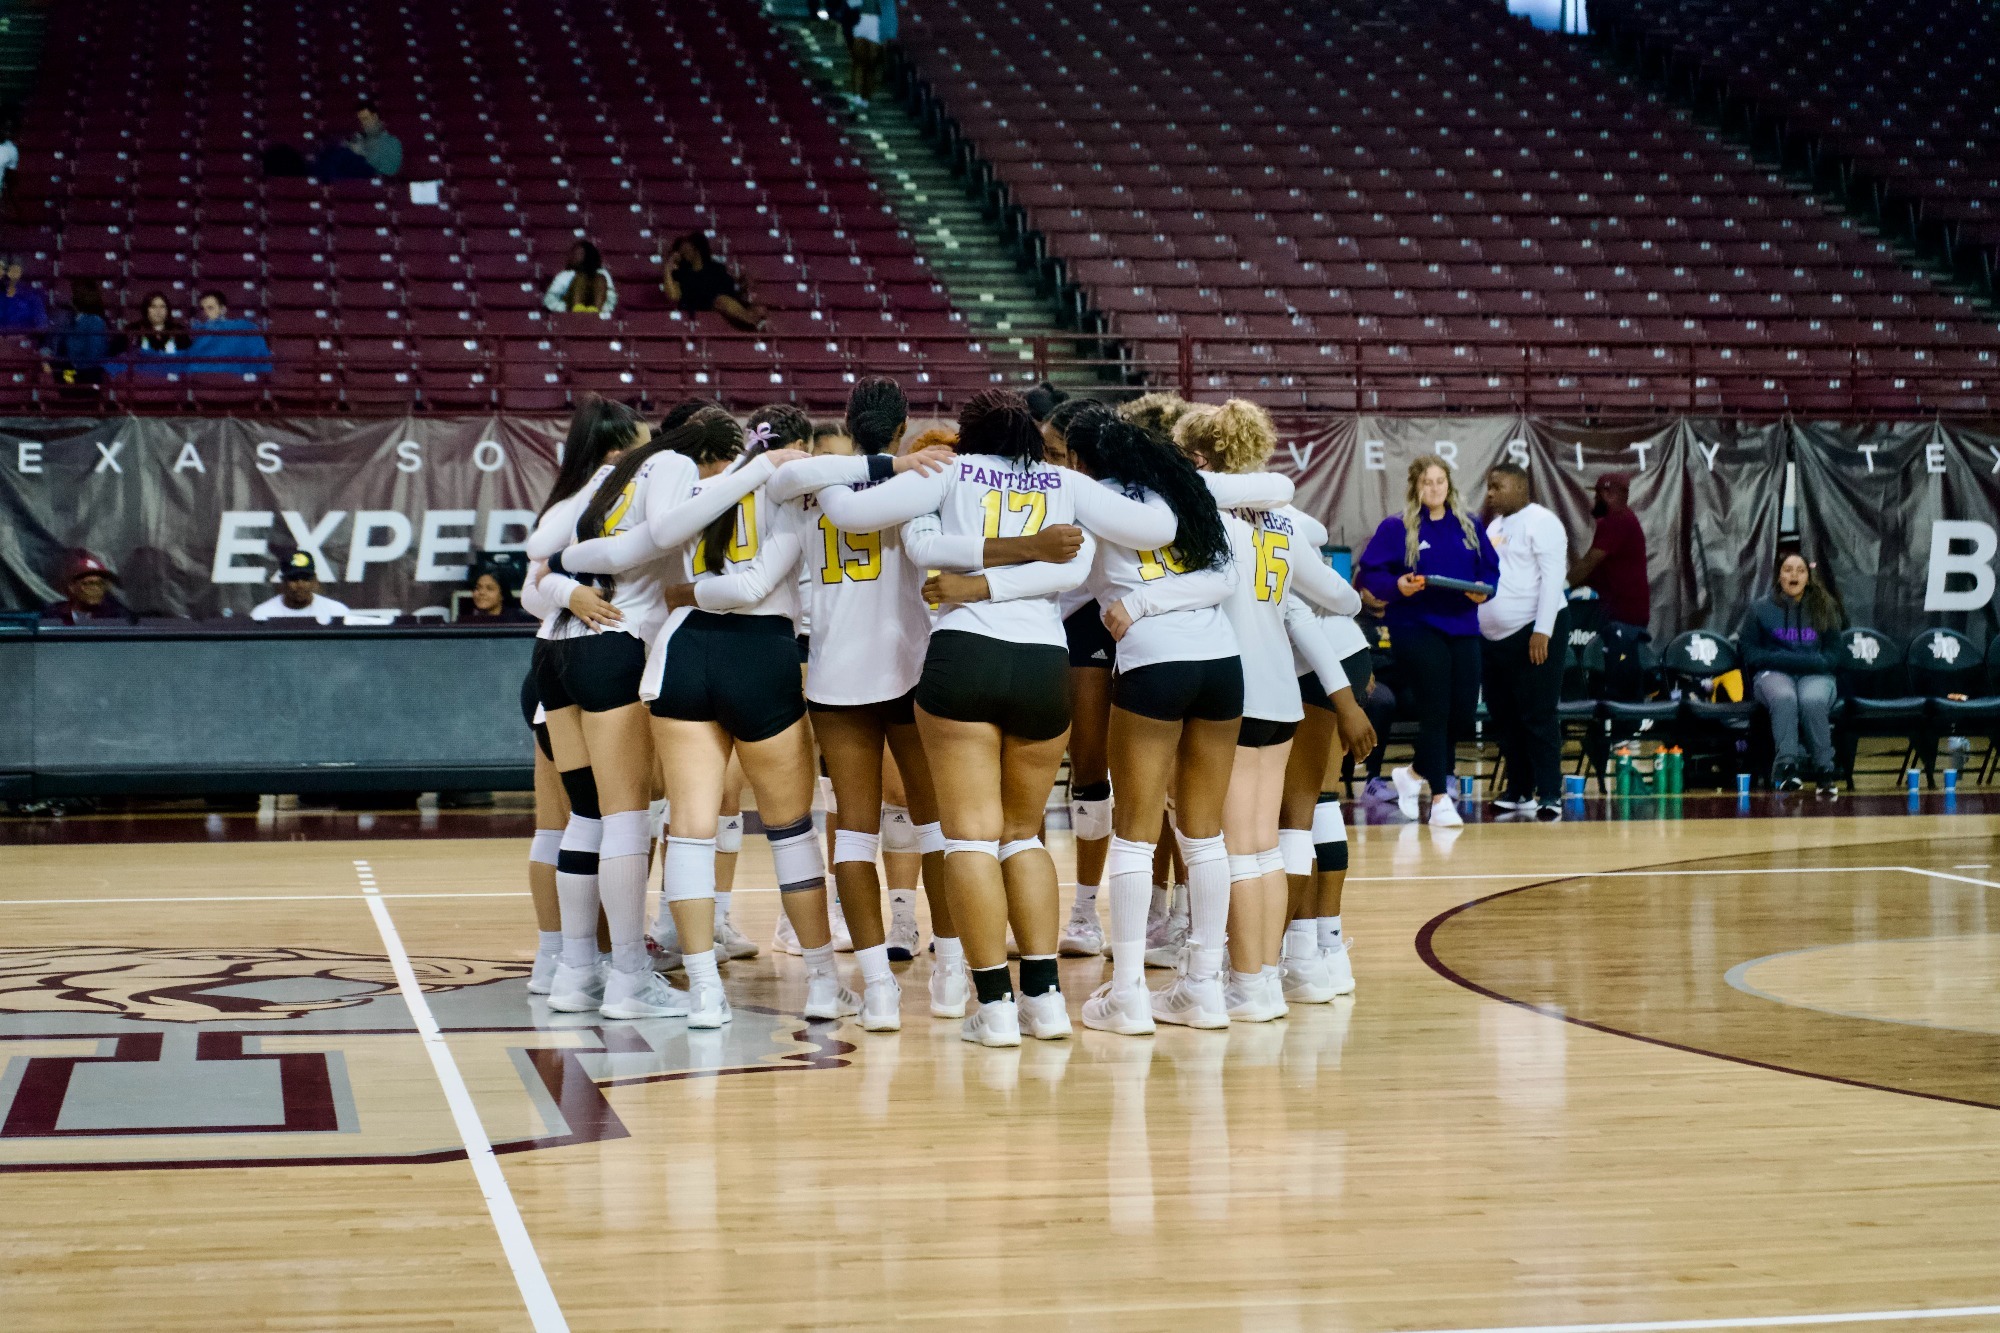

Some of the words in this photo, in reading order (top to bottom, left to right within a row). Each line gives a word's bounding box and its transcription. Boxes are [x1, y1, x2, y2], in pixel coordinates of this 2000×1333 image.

[397, 441, 564, 474] SO
[959, 462, 1062, 491] PANTHERS
[980, 488, 1047, 538] 17
[1229, 506, 1294, 536] ANHERS
[1252, 527, 1290, 606] 15
[1923, 519, 1998, 612] B
